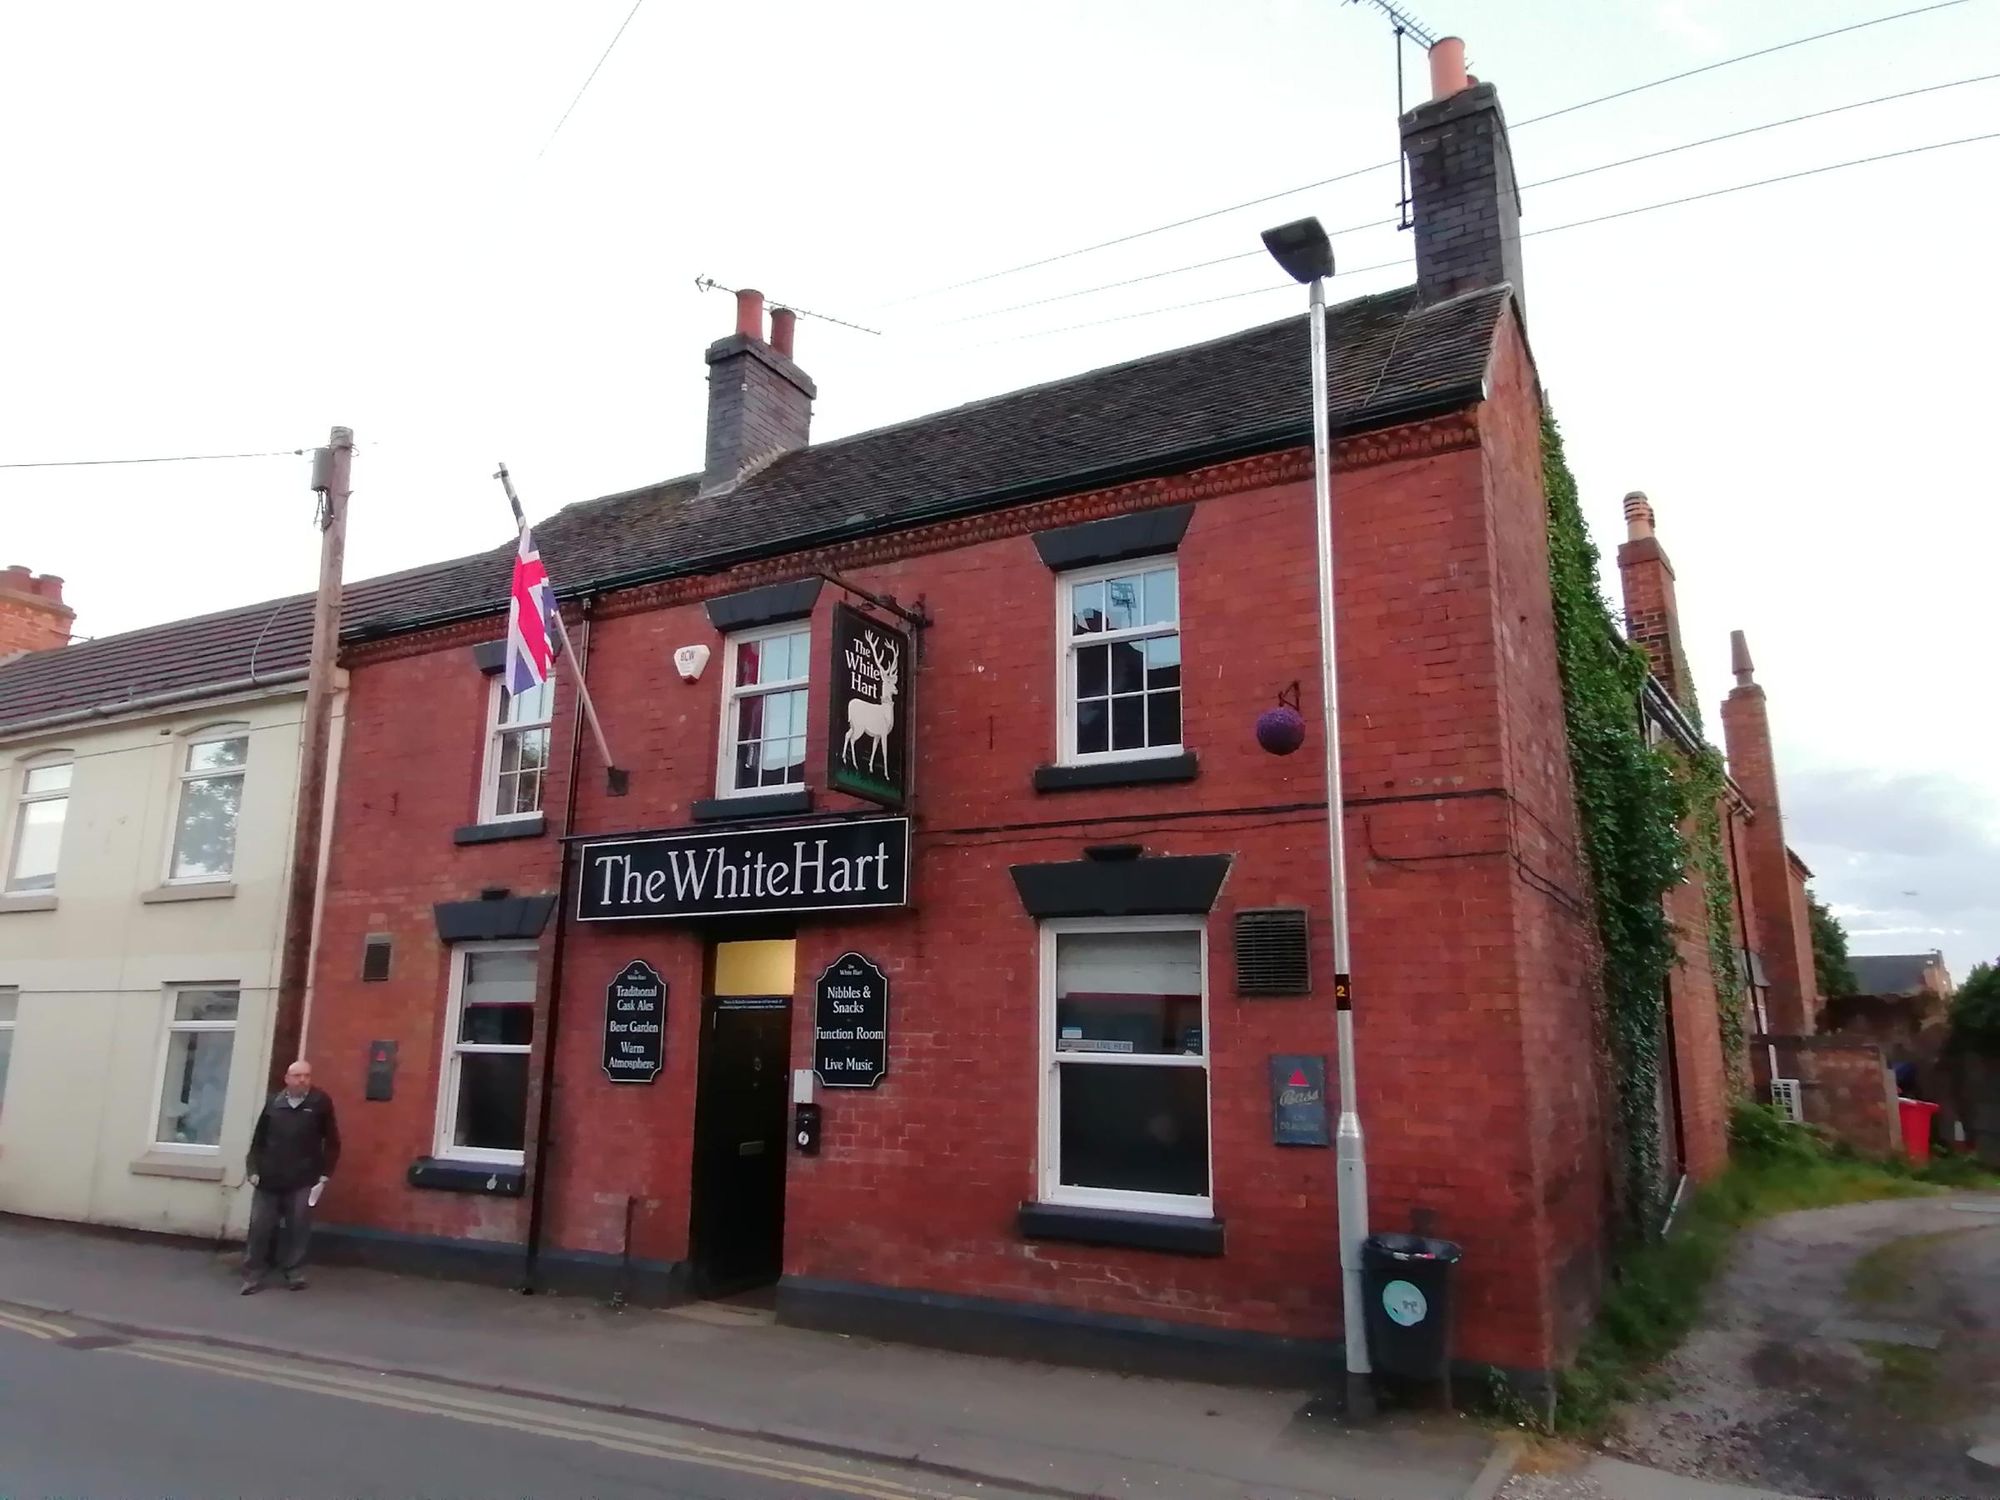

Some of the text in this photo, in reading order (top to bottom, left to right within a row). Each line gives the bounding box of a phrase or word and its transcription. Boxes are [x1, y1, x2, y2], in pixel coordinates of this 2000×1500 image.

[853, 638, 871, 657] The
[845, 649, 881, 681] White
[851, 671, 877, 699] Hart
[616, 985, 658, 997] Traditional
[827, 985, 872, 999] Nibbles &
[1336, 985, 1346, 997] 2
[617, 999, 655, 1011] Cask Ales
[832, 1000, 865, 1014] Snacks
[610, 1020, 659, 1033] Beer Garden
[816, 1026, 884, 1040] Function Room
[620, 1041, 645, 1054] Warm
[608, 1056, 655, 1070] Atmosphere
[824, 1057, 874, 1071] Live Music
[1280, 1089, 1320, 1106] Bass
